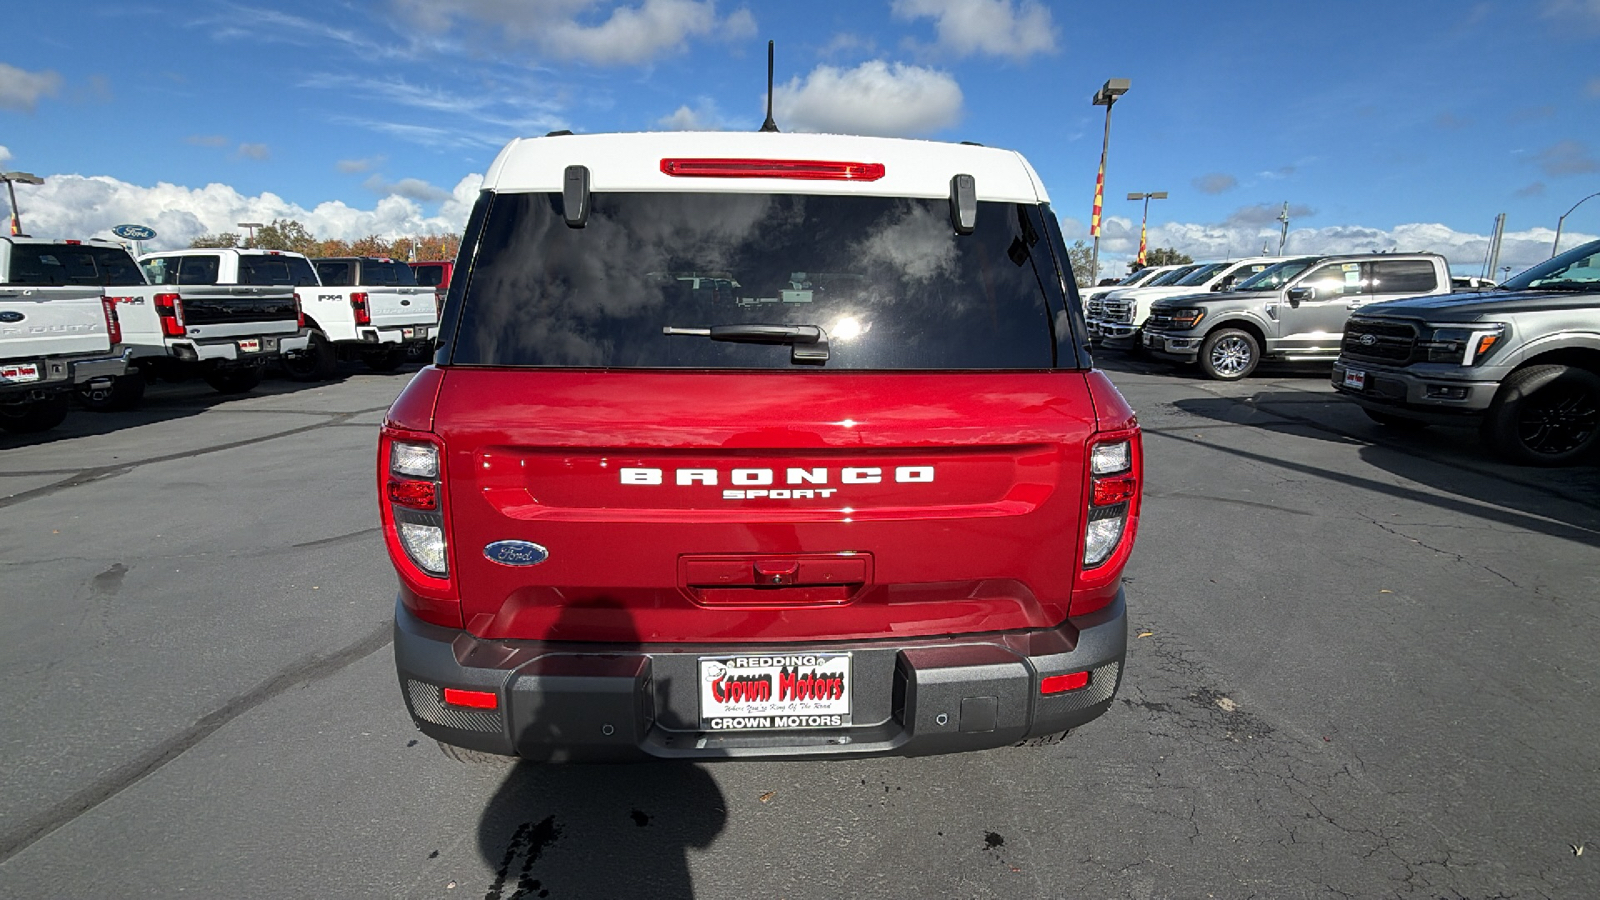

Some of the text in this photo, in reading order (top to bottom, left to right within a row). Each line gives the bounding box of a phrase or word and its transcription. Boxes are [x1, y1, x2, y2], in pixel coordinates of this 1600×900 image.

[123, 226, 150, 238] Ford
[29, 323, 98, 334] DUTY
[620, 466, 935, 486] BRONCO
[723, 488, 837, 499] SPORT
[498, 546, 532, 560] Ford
[736, 657, 816, 667] REDDING
[711, 665, 845, 703] Crown Motors
[711, 715, 841, 729] CROWN MOTORS
